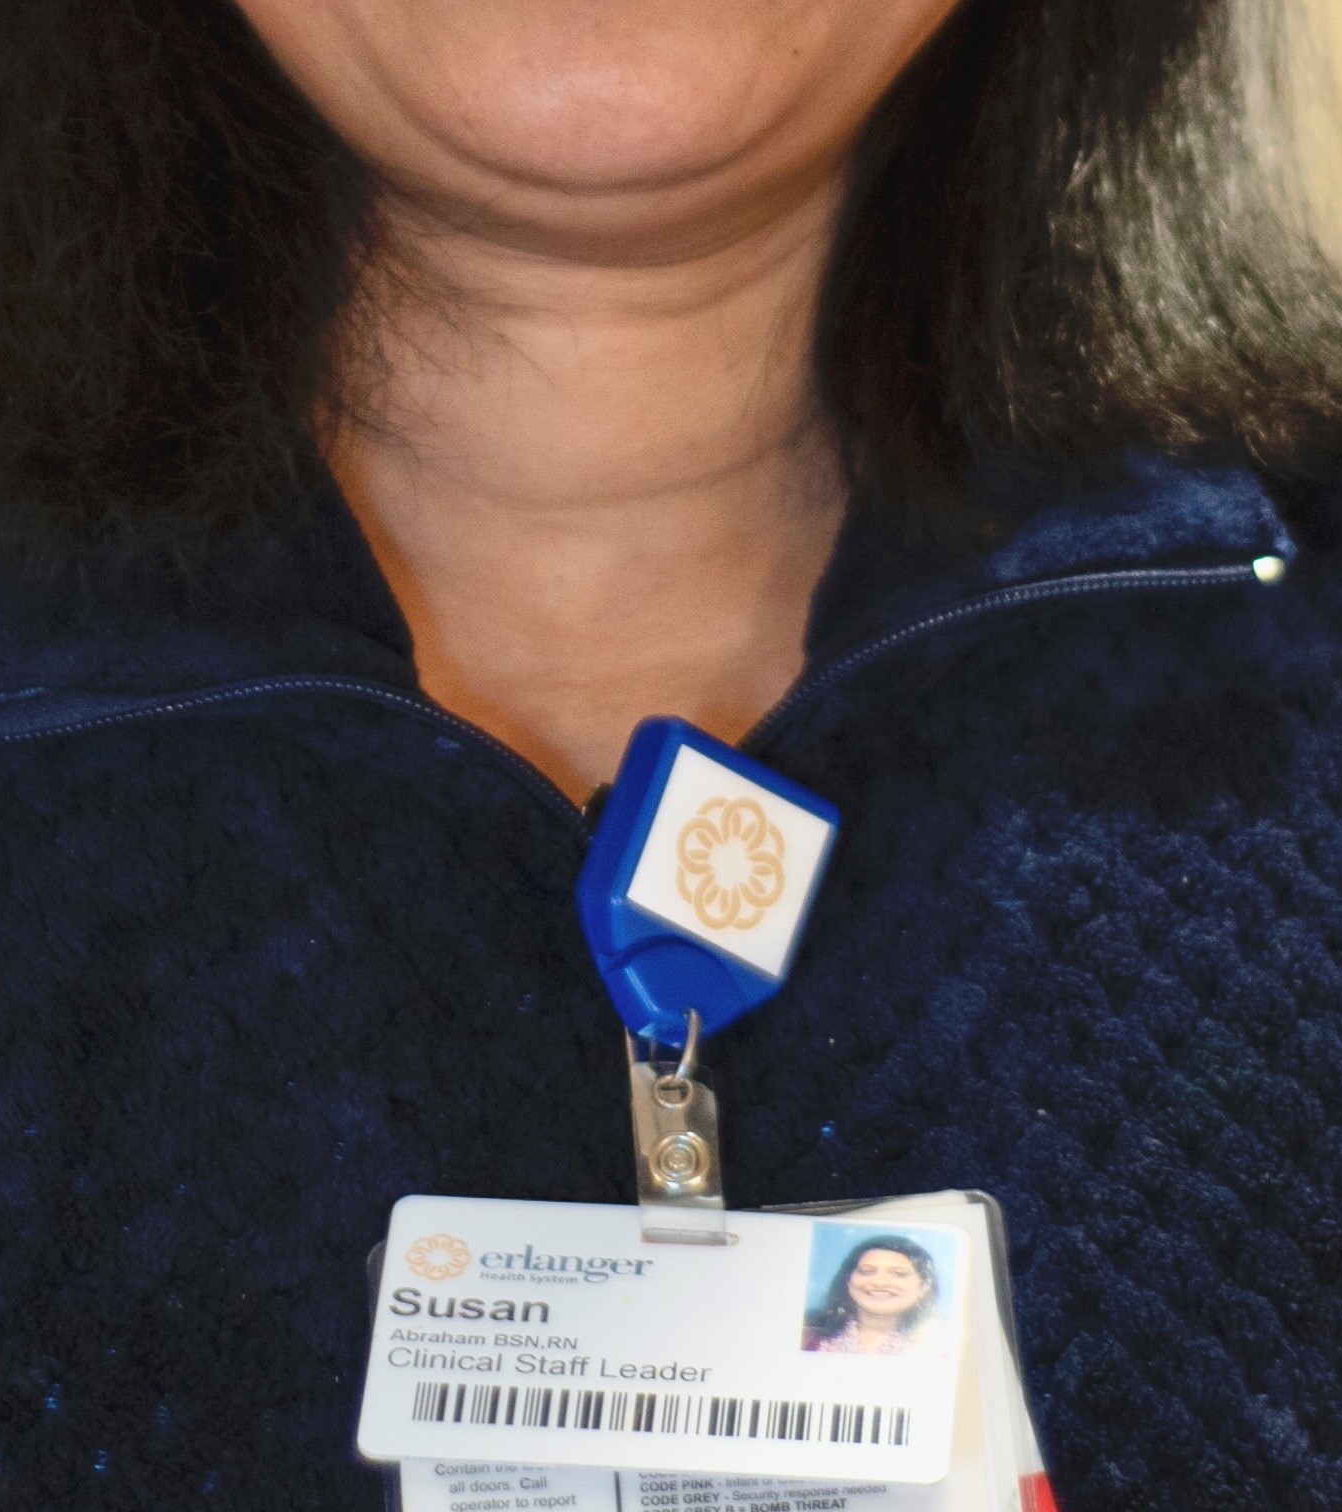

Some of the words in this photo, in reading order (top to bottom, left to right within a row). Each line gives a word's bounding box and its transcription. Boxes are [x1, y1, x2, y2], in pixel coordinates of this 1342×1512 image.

[480, 1244, 654, 1284] erlanger
[480, 1271, 525, 1283] Health
[529, 1273, 578, 1285] System
[389, 1287, 550, 1324] Susan
[389, 1328, 486, 1346] Abraham
[494, 1334, 578, 1351] BSN,RN
[388, 1346, 502, 1373] Clinical
[514, 1353, 591, 1378] Staff
[600, 1358, 712, 1383] Leader
[435, 1463, 491, 1477] Contain
[449, 1481, 465, 1494] all
[520, 1477, 548, 1490] Call
[640, 1480, 678, 1493] CODE
[682, 1479, 714, 1491] PINK
[515, 1497, 529, 1508] to
[533, 1494, 576, 1510] report
[641, 1494, 679, 1507] CODE
[683, 1492, 720, 1505] GREY
[732, 1488, 780, 1503] Security
[784, 1486, 839, 1502] response
[842, 1483, 887, 1496] needed
[795, 1498, 847, 1512] THREAT
